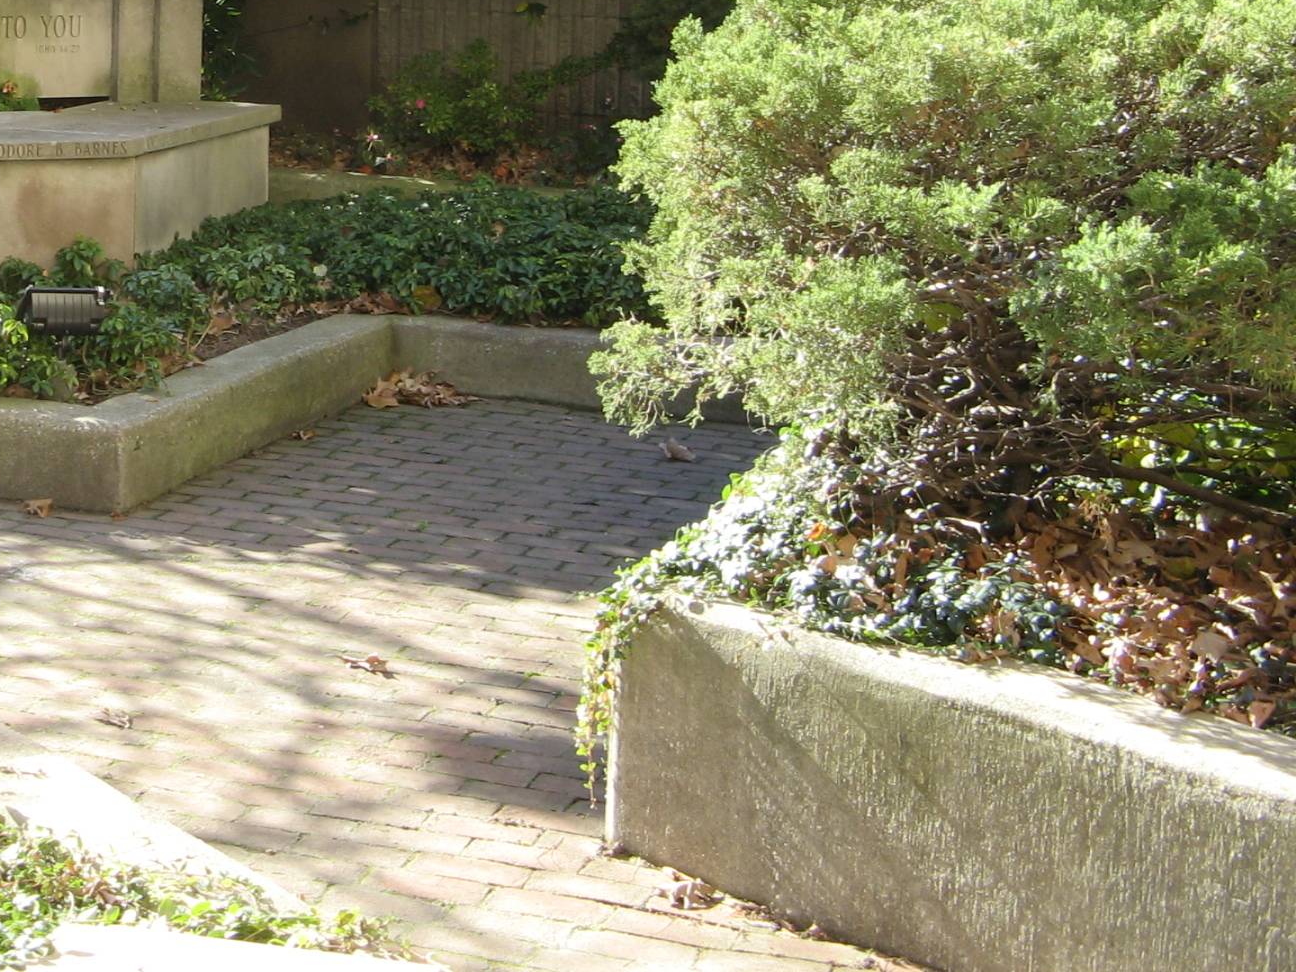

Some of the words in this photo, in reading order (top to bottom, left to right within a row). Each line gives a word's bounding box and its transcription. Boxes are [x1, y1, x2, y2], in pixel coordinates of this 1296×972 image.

[1, 15, 27, 39] TO
[40, 14, 82, 39] YOU
[74, 140, 128, 156] BARNES
